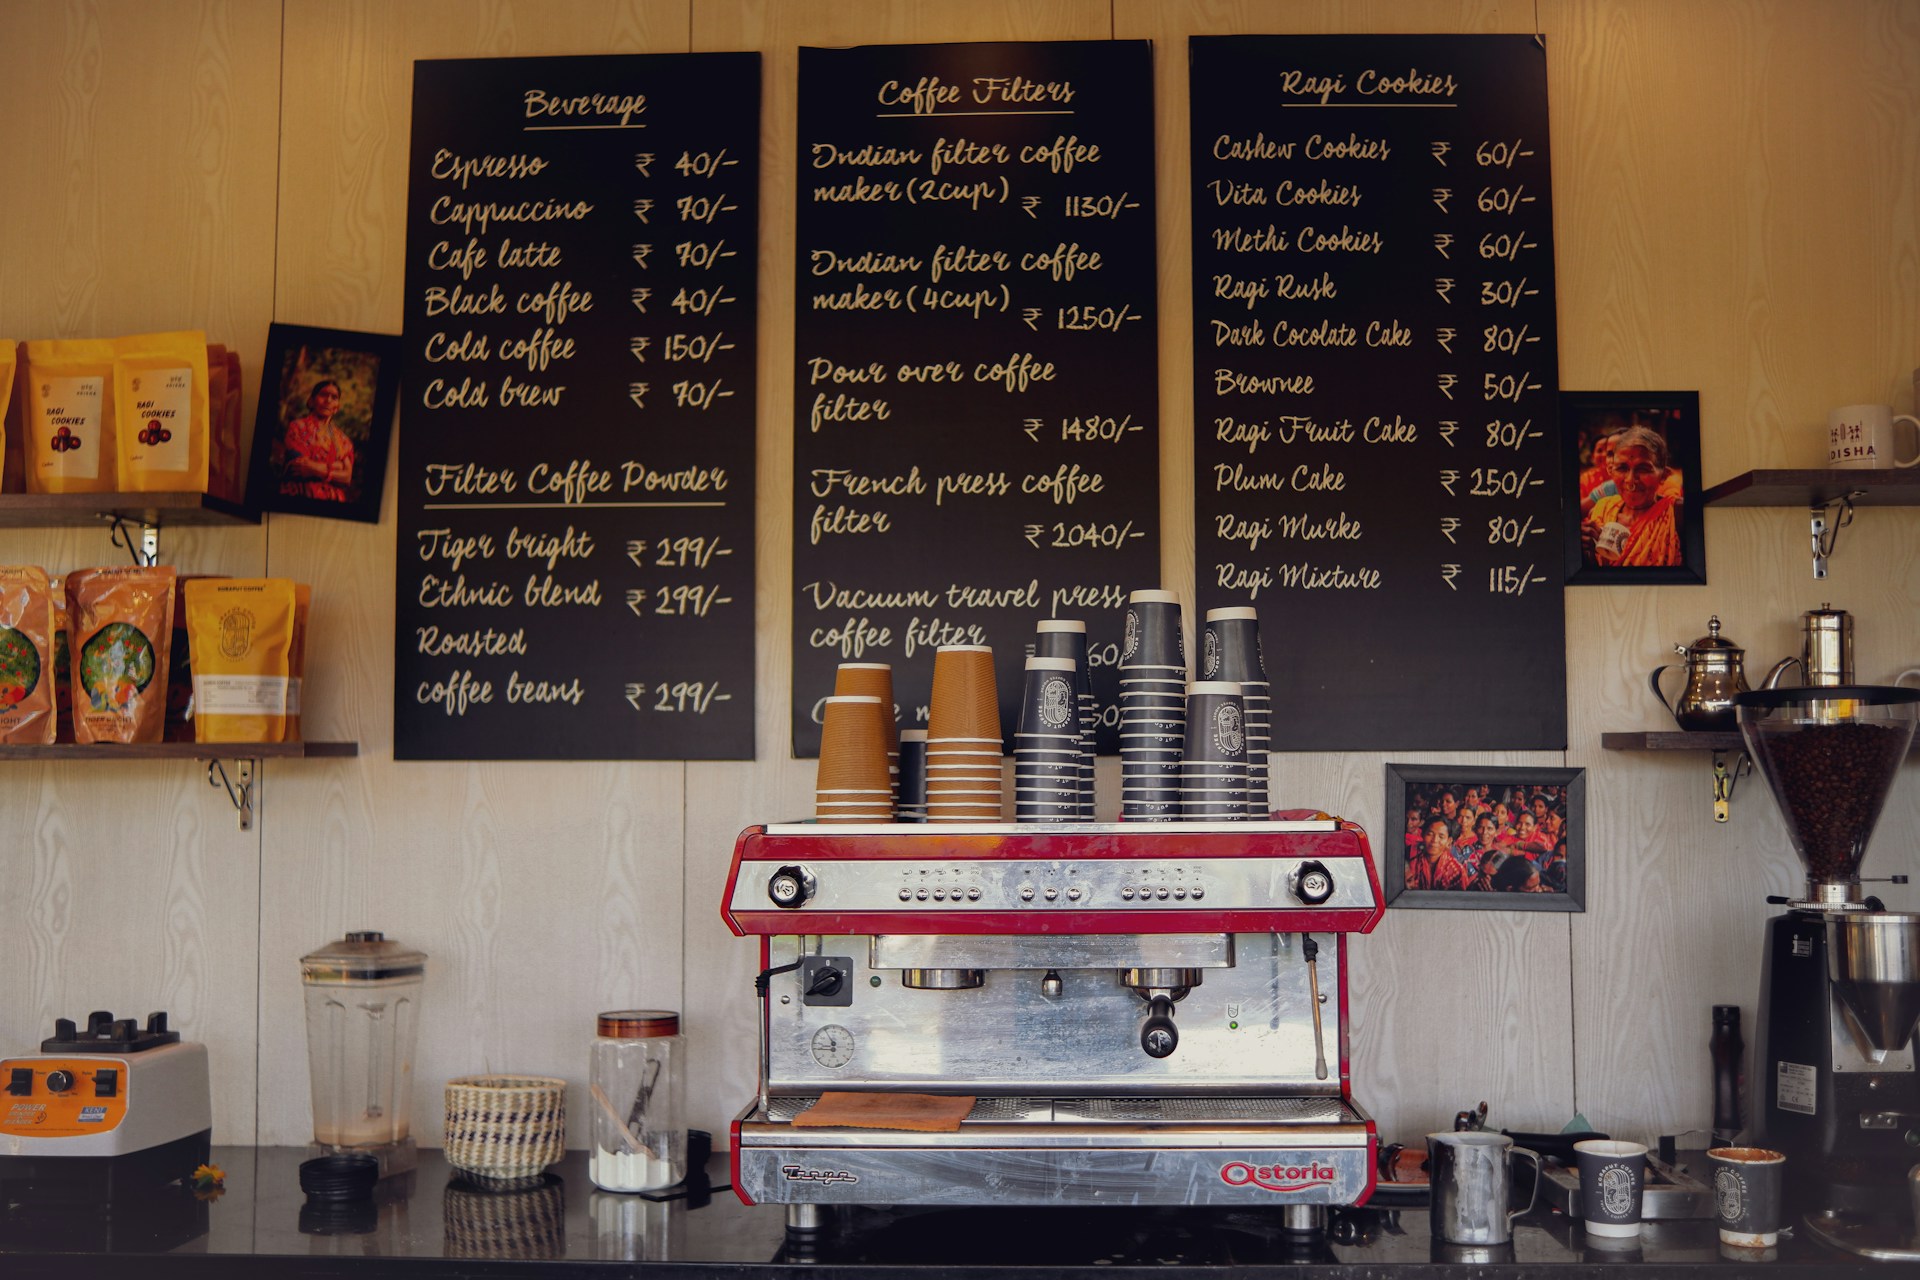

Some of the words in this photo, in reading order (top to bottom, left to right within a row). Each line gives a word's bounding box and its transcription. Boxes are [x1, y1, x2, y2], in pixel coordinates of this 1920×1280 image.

[878, 77, 961, 114] Coffee
[972, 75, 1076, 104] Filters
[1280, 71, 1346, 104] Ragi
[1356, 68, 1458, 97] Cookies
[525, 89, 647, 125] Beverage
[431, 147, 549, 190] Espresso
[674, 148, 739, 179] 40/-
[811, 143, 923, 169] Indian
[931, 137, 1010, 176] filter
[1019, 135, 1101, 174] coffee
[1213, 132, 1297, 161] Cashew
[1304, 132, 1391, 161] Cookies
[1475, 138, 1535, 169] 60/-
[430, 195, 594, 236] Cappuccino
[676, 194, 738, 225] 70/-
[1065, 191, 1140, 220] 1130/-
[1206, 179, 1268, 207] Vita
[1275, 178, 1362, 208] Cookies
[1477, 184, 1536, 215] 60/-
[428, 237, 488, 281] Cafe
[497, 238, 562, 269] latte
[675, 239, 737, 271] 70/-
[1212, 223, 1290, 253] Methi
[1297, 224, 1384, 254] Cookies
[1479, 230, 1538, 262] 60/-
[811, 249, 923, 276] Indian
[931, 244, 1011, 284] filter
[1020, 242, 1103, 282] coffee
[424, 283, 508, 317] Black
[516, 281, 593, 325] coffee
[671, 285, 736, 317] 40/-
[1212, 273, 1270, 310] Ragi
[1274, 271, 1337, 301] Rusk
[1480, 277, 1539, 308] 30/-
[1058, 303, 1142, 333] 1250/-
[1210, 318, 1266, 347] Dark
[1272, 319, 1358, 347] Cocolate
[1365, 319, 1412, 348] Cake
[1483, 324, 1541, 356] 80/-
[424, 330, 491, 363] Cold
[498, 327, 576, 372] coffee
[664, 331, 736, 364] 150/-
[807, 356, 887, 386] Pour
[896, 361, 964, 383] over
[973, 352, 1057, 393] coffee
[1214, 368, 1315, 396] Brownee
[1483, 371, 1542, 403] 50/-
[46, 407, 65, 416] RAGI
[137, 400, 155, 410] RAGI
[423, 376, 489, 409] Cold
[499, 375, 566, 408] brew
[672, 378, 735, 411] 70/-
[51, 416, 86, 426] COOKIES
[141, 409, 177, 419] COOKIES
[810, 392, 891, 433] filter
[1061, 414, 1144, 444] 1480/-
[1214, 416, 1272, 454] Ragi
[1279, 415, 1355, 444] Fruit
[1363, 414, 1418, 444] Cake
[1486, 419, 1544, 451] 80/-
[425, 462, 517, 496] Filter
[528, 460, 614, 504] Coffee
[620, 460, 728, 493] Powder
[810, 465, 927, 498] French
[936, 472, 1012, 506] press
[1021, 463, 1105, 505] coffee
[1213, 462, 1285, 492] Plum
[1290, 462, 1346, 492] Cake
[1469, 466, 1545, 499] 250/-
[810, 504, 891, 545] filter
[1051, 520, 1145, 550] 2040/-
[1214, 513, 1273, 552] Ragi
[1278, 511, 1362, 541] Murke
[1487, 515, 1546, 548] 80/-
[417, 527, 496, 572] Tiger
[506, 525, 595, 571] bright
[655, 536, 733, 569] 299/-
[419, 574, 514, 608] Ethnic
[524, 574, 602, 607] blend
[655, 584, 732, 617] 299/-
[802, 581, 939, 610] Vacuum
[945, 578, 1041, 609] travel
[1051, 584, 1127, 619] press
[1215, 562, 1273, 601] Ragi
[1278, 562, 1382, 590] Mixture
[1489, 563, 1547, 596] 115/-
[416, 625, 528, 658] Roasted
[809, 617, 893, 659] coffee
[906, 617, 986, 658] filter
[416, 669, 493, 716] coffee
[506, 670, 585, 706] beans
[654, 681, 732, 714] 299/-
[10, 1103, 47, 1111] POWER
[84, 1106, 105, 1114] KENT
[1598, 1163, 1618, 1187] KORAPUT
[1620, 1164, 1636, 1186] COFFEE
